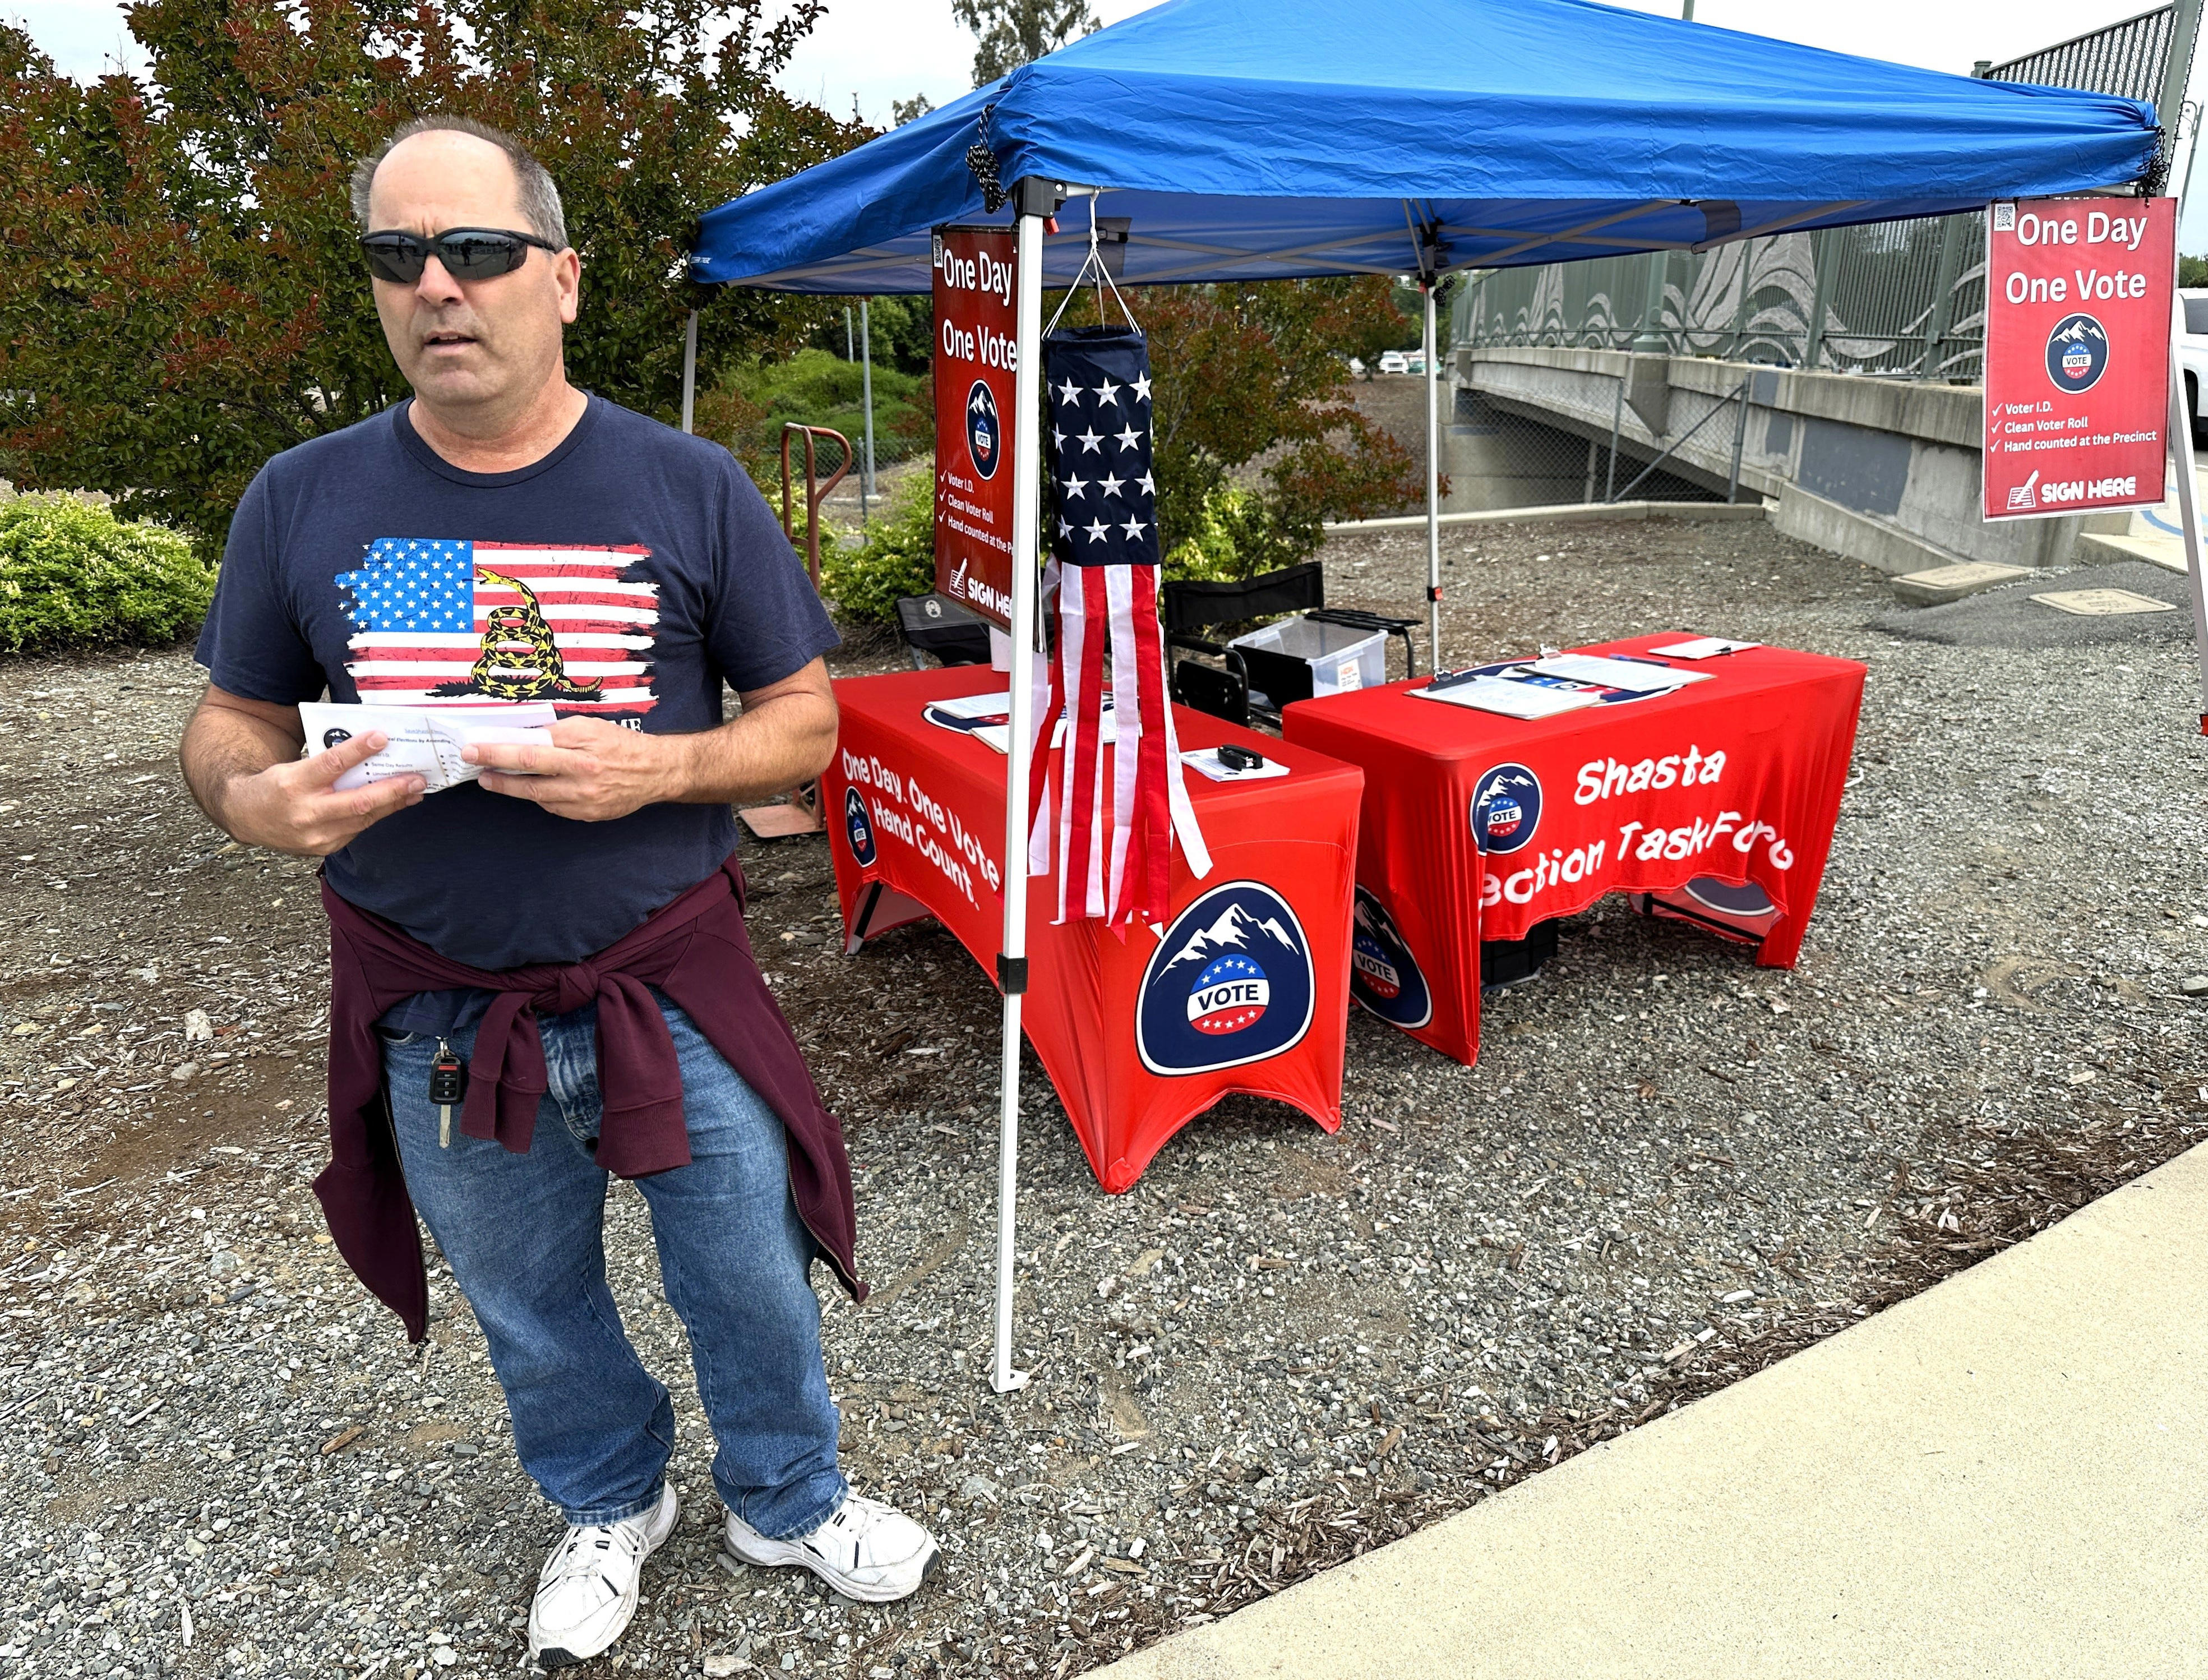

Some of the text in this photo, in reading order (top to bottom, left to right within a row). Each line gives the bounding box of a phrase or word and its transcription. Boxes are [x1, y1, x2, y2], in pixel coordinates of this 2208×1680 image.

[2017, 211, 2147, 251] One Day
[944, 248, 1012, 306] One Day
[2006, 269, 2146, 304] One Vote
[943, 319, 1017, 372] One Vote
[2066, 357, 2087, 365] VOTE
[2006, 401, 2053, 415] Voter I.D.
[977, 433, 988, 446] VOTE
[2004, 416, 2088, 433] Clean Voter Roll
[2004, 430, 2157, 452] Hand counted at the Precinct
[948, 472, 974, 493] Voter I.D.
[2041, 476, 2136, 503] SIGN HERE
[948, 494, 994, 524] Clean Voter Roll
[948, 515, 963, 532] Hand
[964, 525, 988, 543] counted
[990, 536, 996, 547] at
[996, 537, 1006, 552] the
[968, 577, 1012, 619] SIGN HE
[1574, 744, 1726, 805] Shasta
[843, 747, 871, 783] One
[909, 777, 947, 833] One
[946, 807, 1000, 892] Vote
[871, 796, 914, 847] Hand
[1480, 839, 1606, 907] ection
[1357, 954, 1393, 981] VOTE
[1198, 984, 1258, 1010] VOTE
